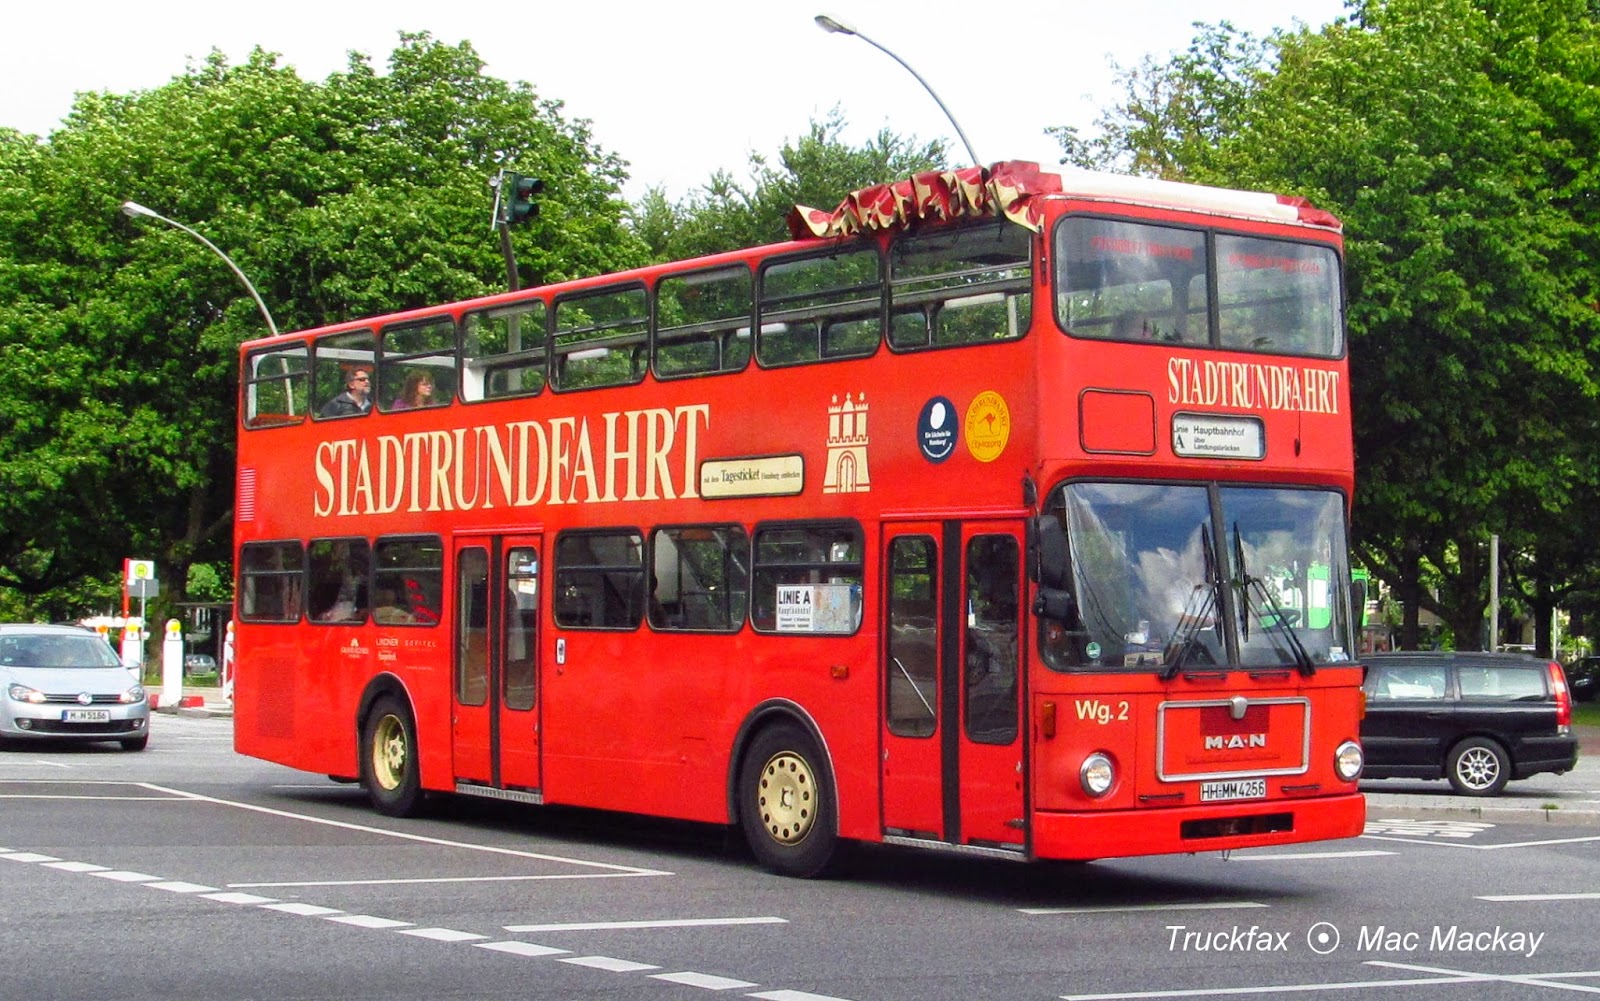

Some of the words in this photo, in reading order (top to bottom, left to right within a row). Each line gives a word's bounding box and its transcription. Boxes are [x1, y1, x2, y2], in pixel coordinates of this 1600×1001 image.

[1168, 356, 1340, 414] STADTRUNDFAHRT
[1193, 425, 1245, 436] Hauptbahnhof
[1174, 434, 1185, 449] A
[313, 403, 711, 518] STADTRUNDFAHRT
[721, 468, 760, 484] Tagesticket
[779, 590, 800, 605] LINIE
[803, 590, 811, 605] A
[1074, 699, 1114, 725] Wg.
[1117, 700, 1129, 720] 2
[1238, 781, 1265, 797] 4256
